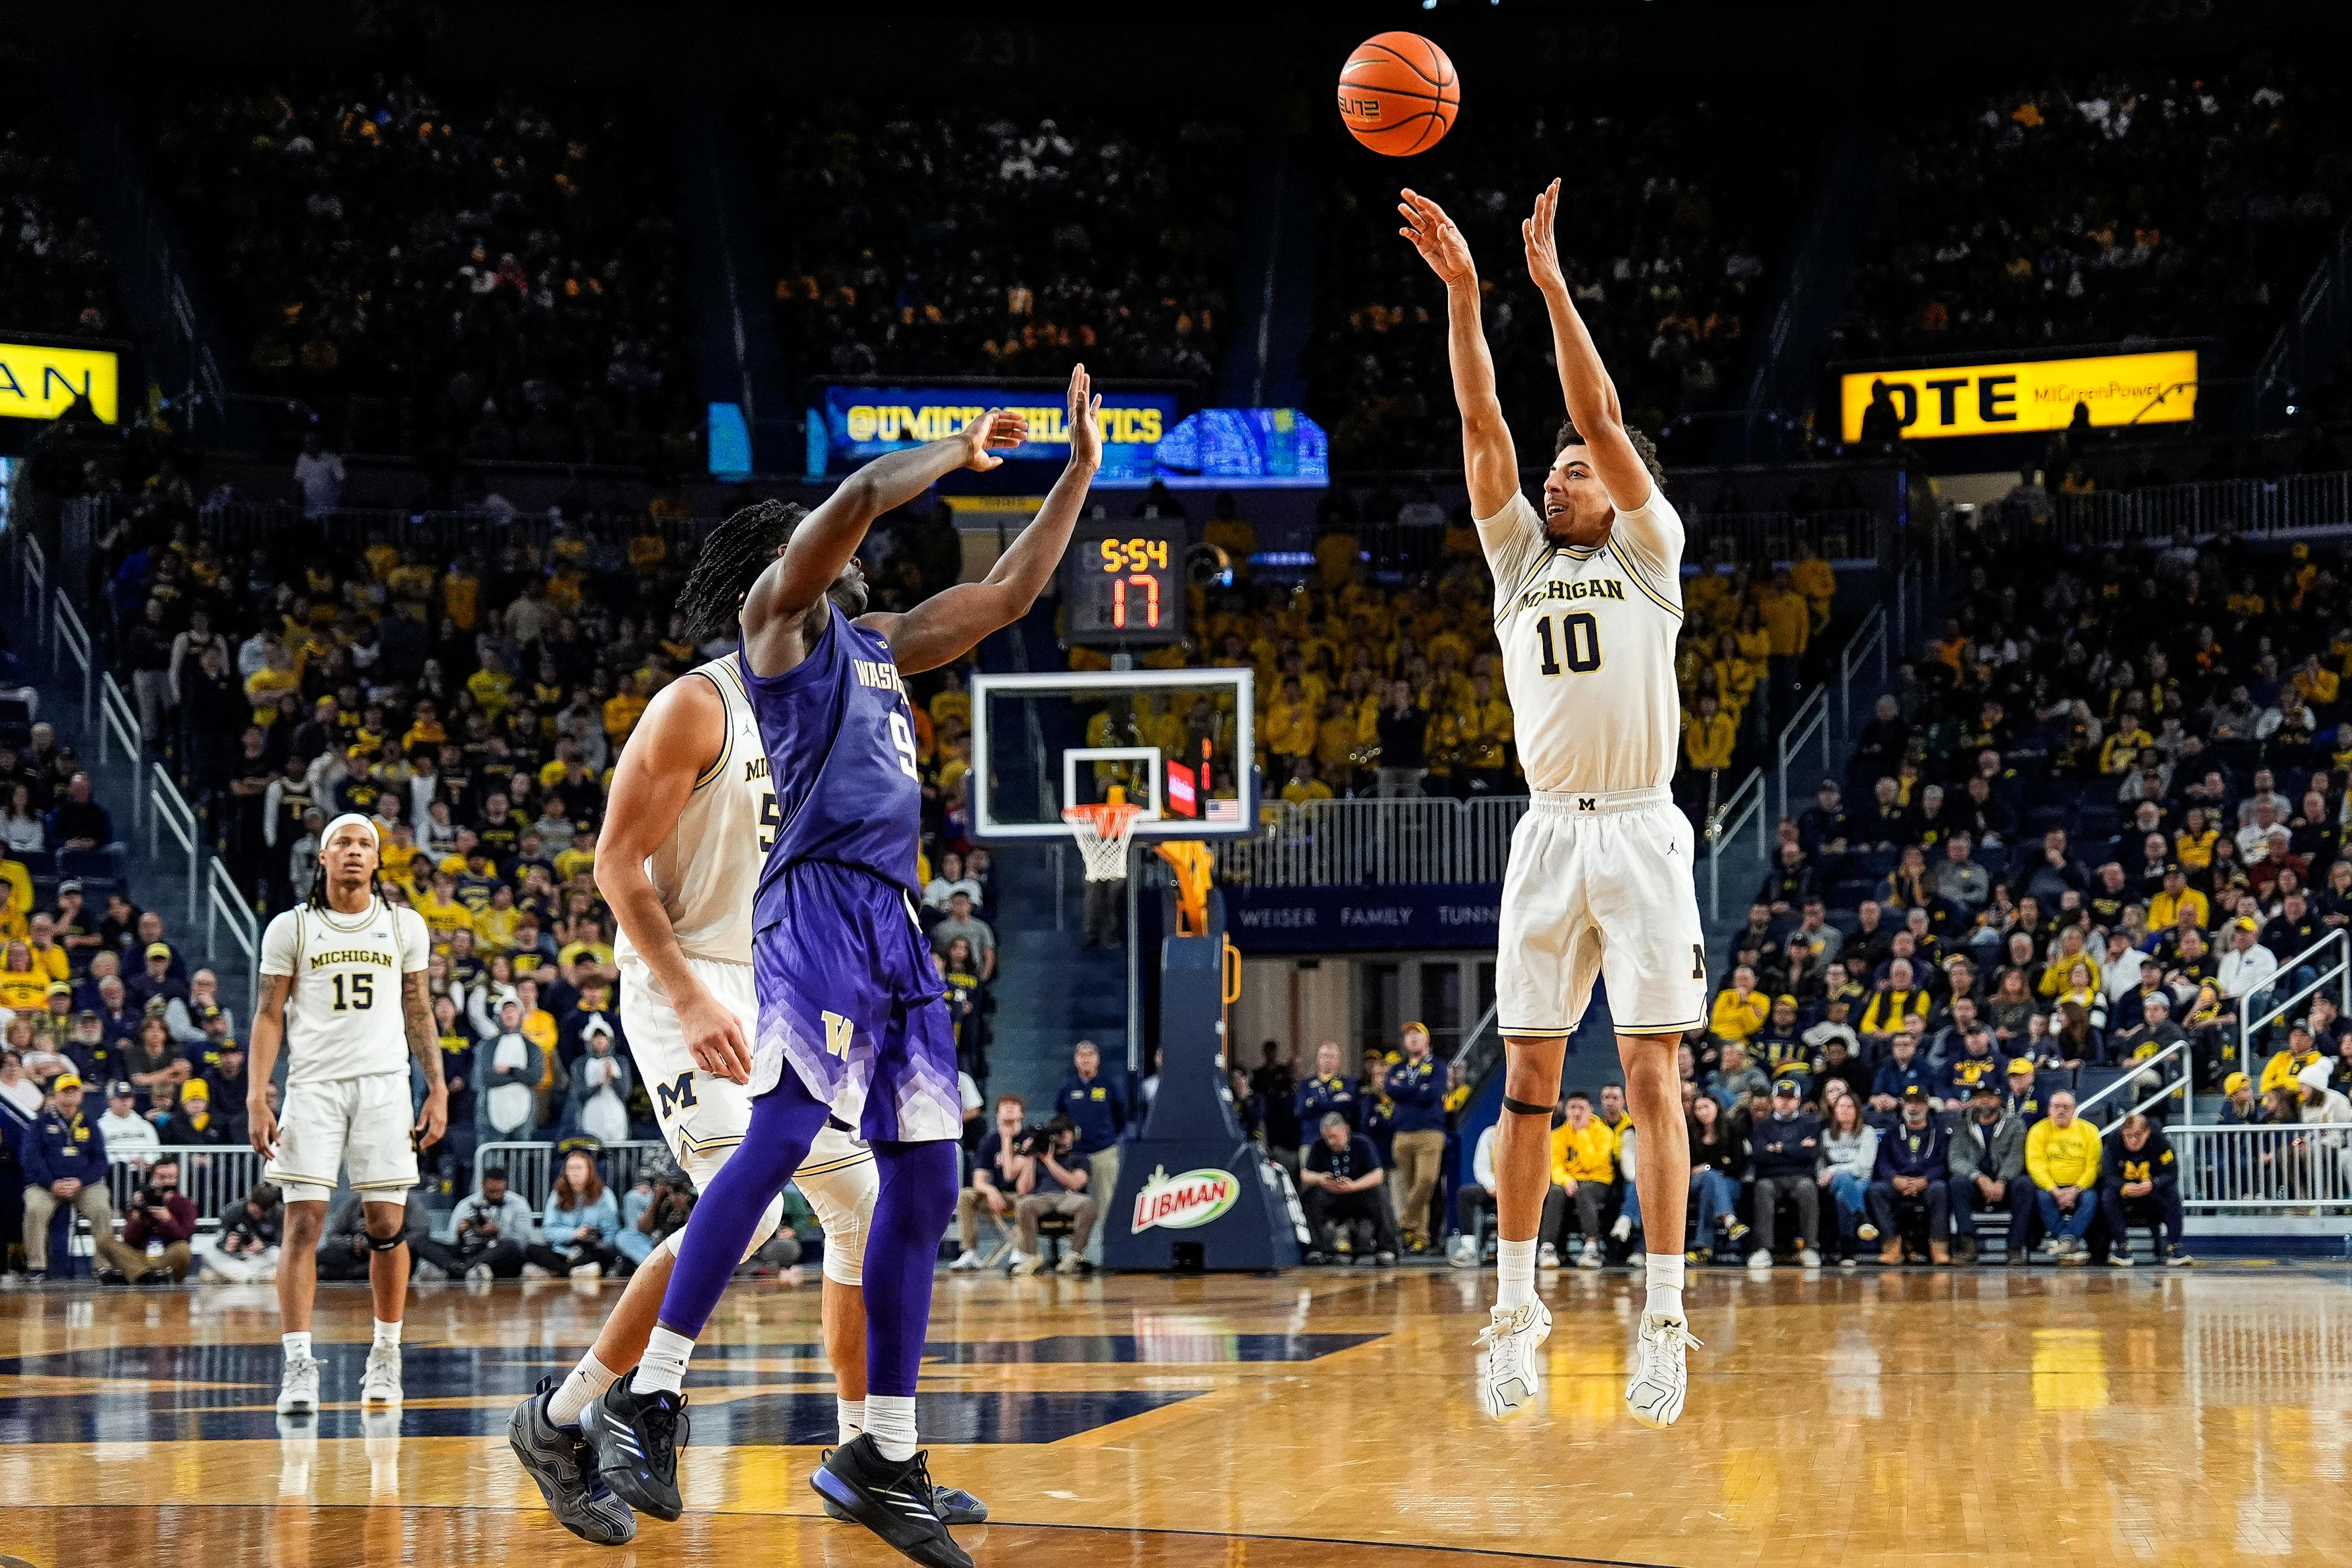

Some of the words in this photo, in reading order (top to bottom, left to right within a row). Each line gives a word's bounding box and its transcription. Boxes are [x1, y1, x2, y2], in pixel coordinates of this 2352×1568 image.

[960, 29, 1037, 66] 231
[848, 405, 1162, 442] @UMICHHLTICS
[1101, 538, 1167, 572] 5:54
[1114, 574, 1159, 628] 17
[1520, 579, 1626, 613] MIHIGAN
[1536, 611, 1603, 677] 10
[888, 710, 919, 783] 9
[1578, 798, 1596, 811] M
[1239, 907, 1317, 928] WEISER
[1341, 907, 1413, 926] FAMILY
[1438, 906, 1501, 926] TUNN
[310, 950, 392, 969] MICHIGAN
[332, 972, 374, 1011] 15
[821, 1010, 854, 1063] W
[656, 1068, 700, 1121] M
[1137, 1179, 1228, 1226] LIBMAN
